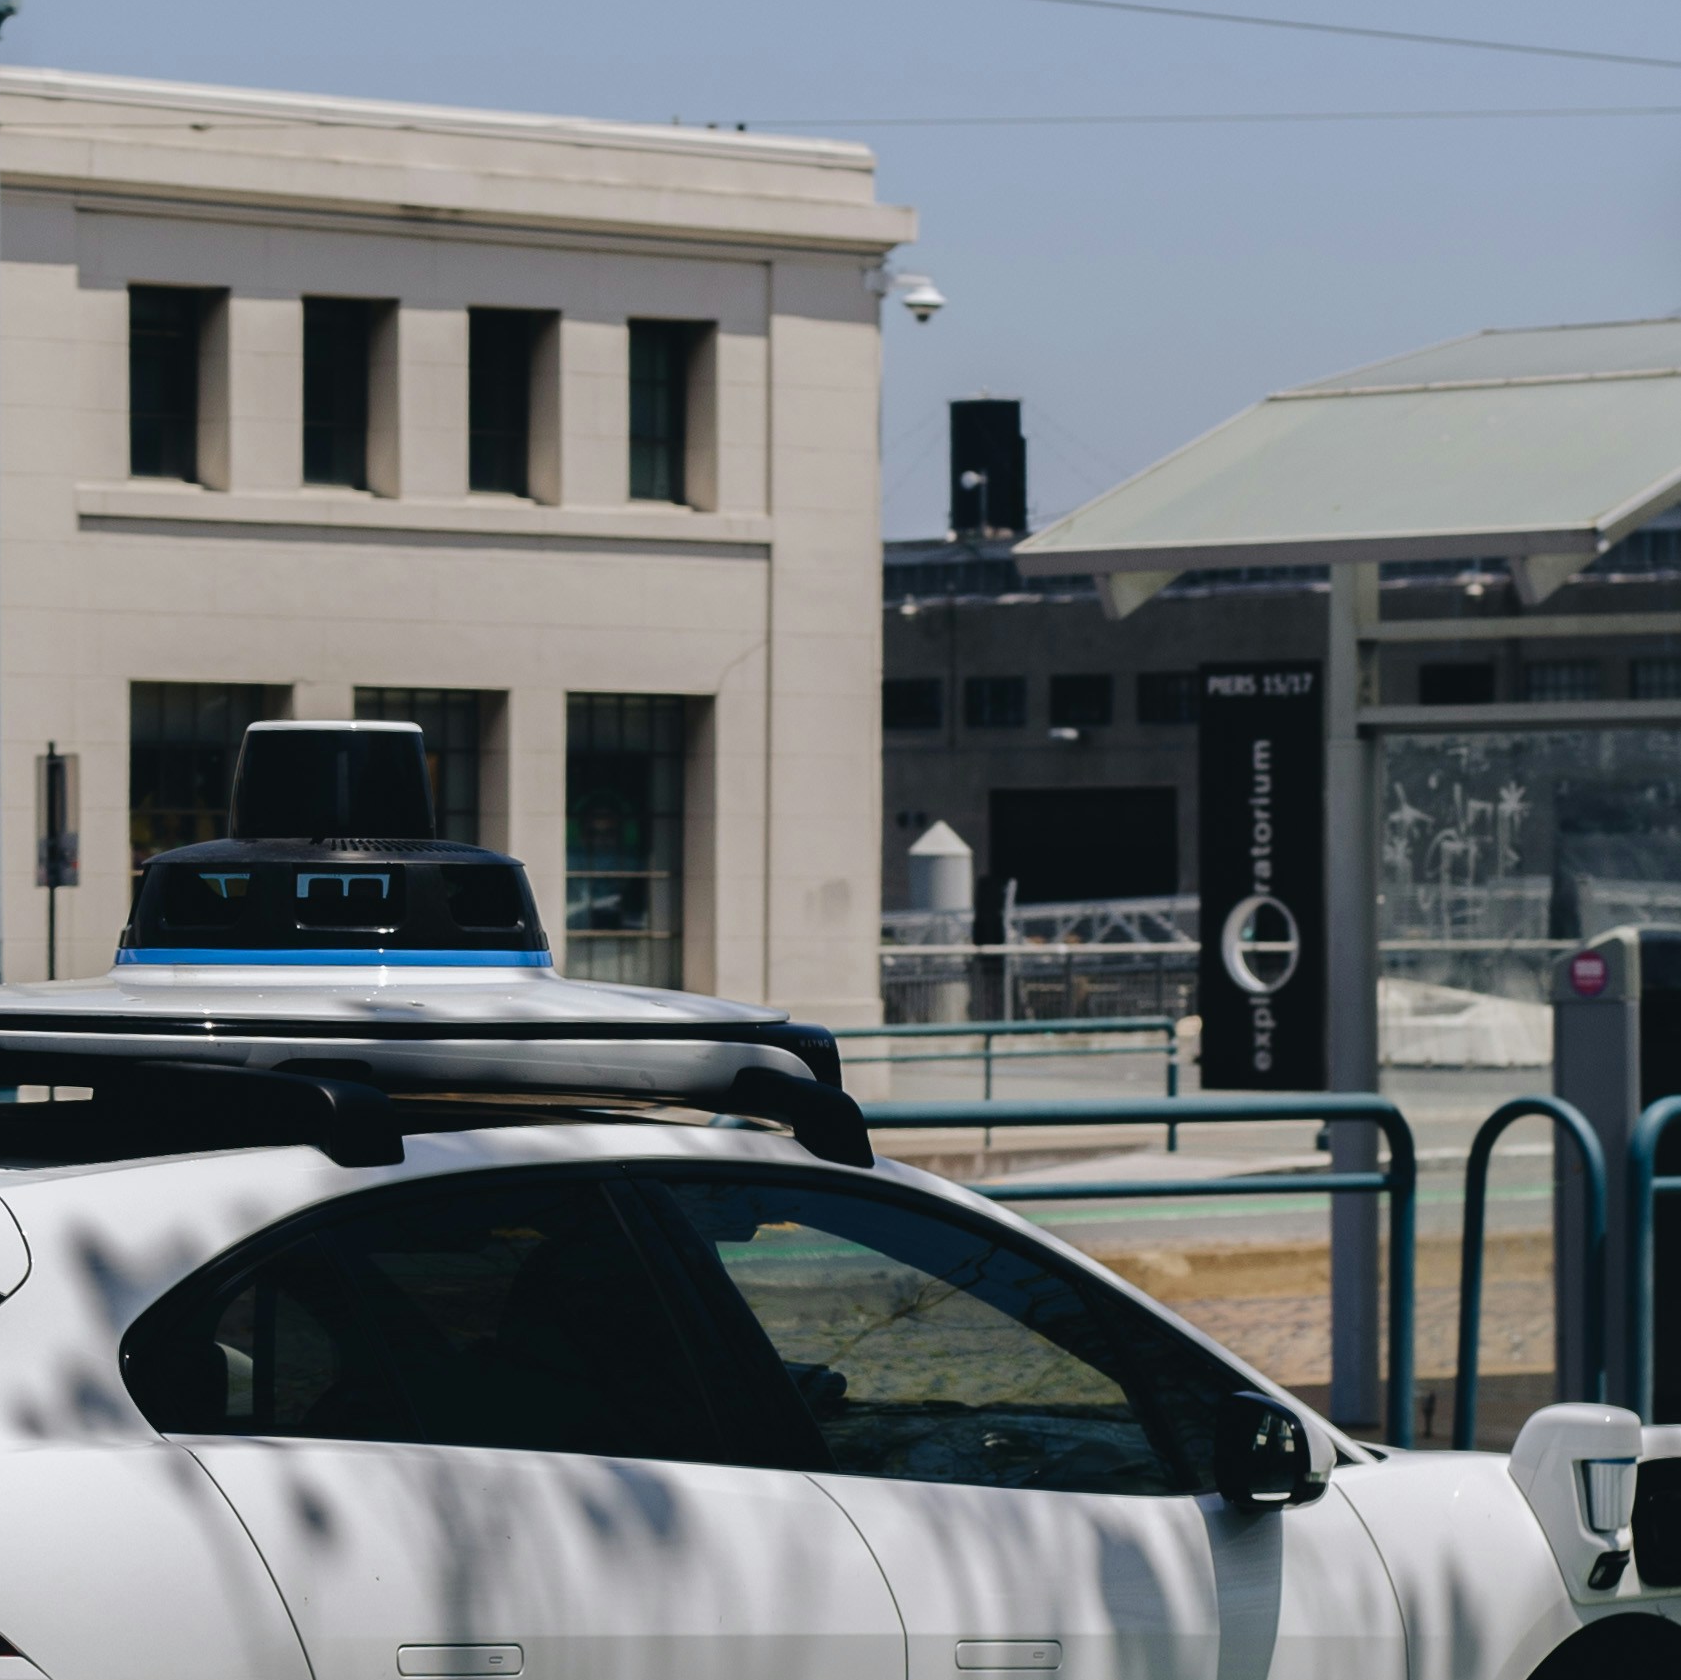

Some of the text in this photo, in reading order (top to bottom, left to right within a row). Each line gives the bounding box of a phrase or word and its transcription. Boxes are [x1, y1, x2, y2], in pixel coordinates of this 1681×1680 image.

[1208, 672, 1313, 697] PIERS 15/17
[1221, 739, 1300, 1072] exploratorium
